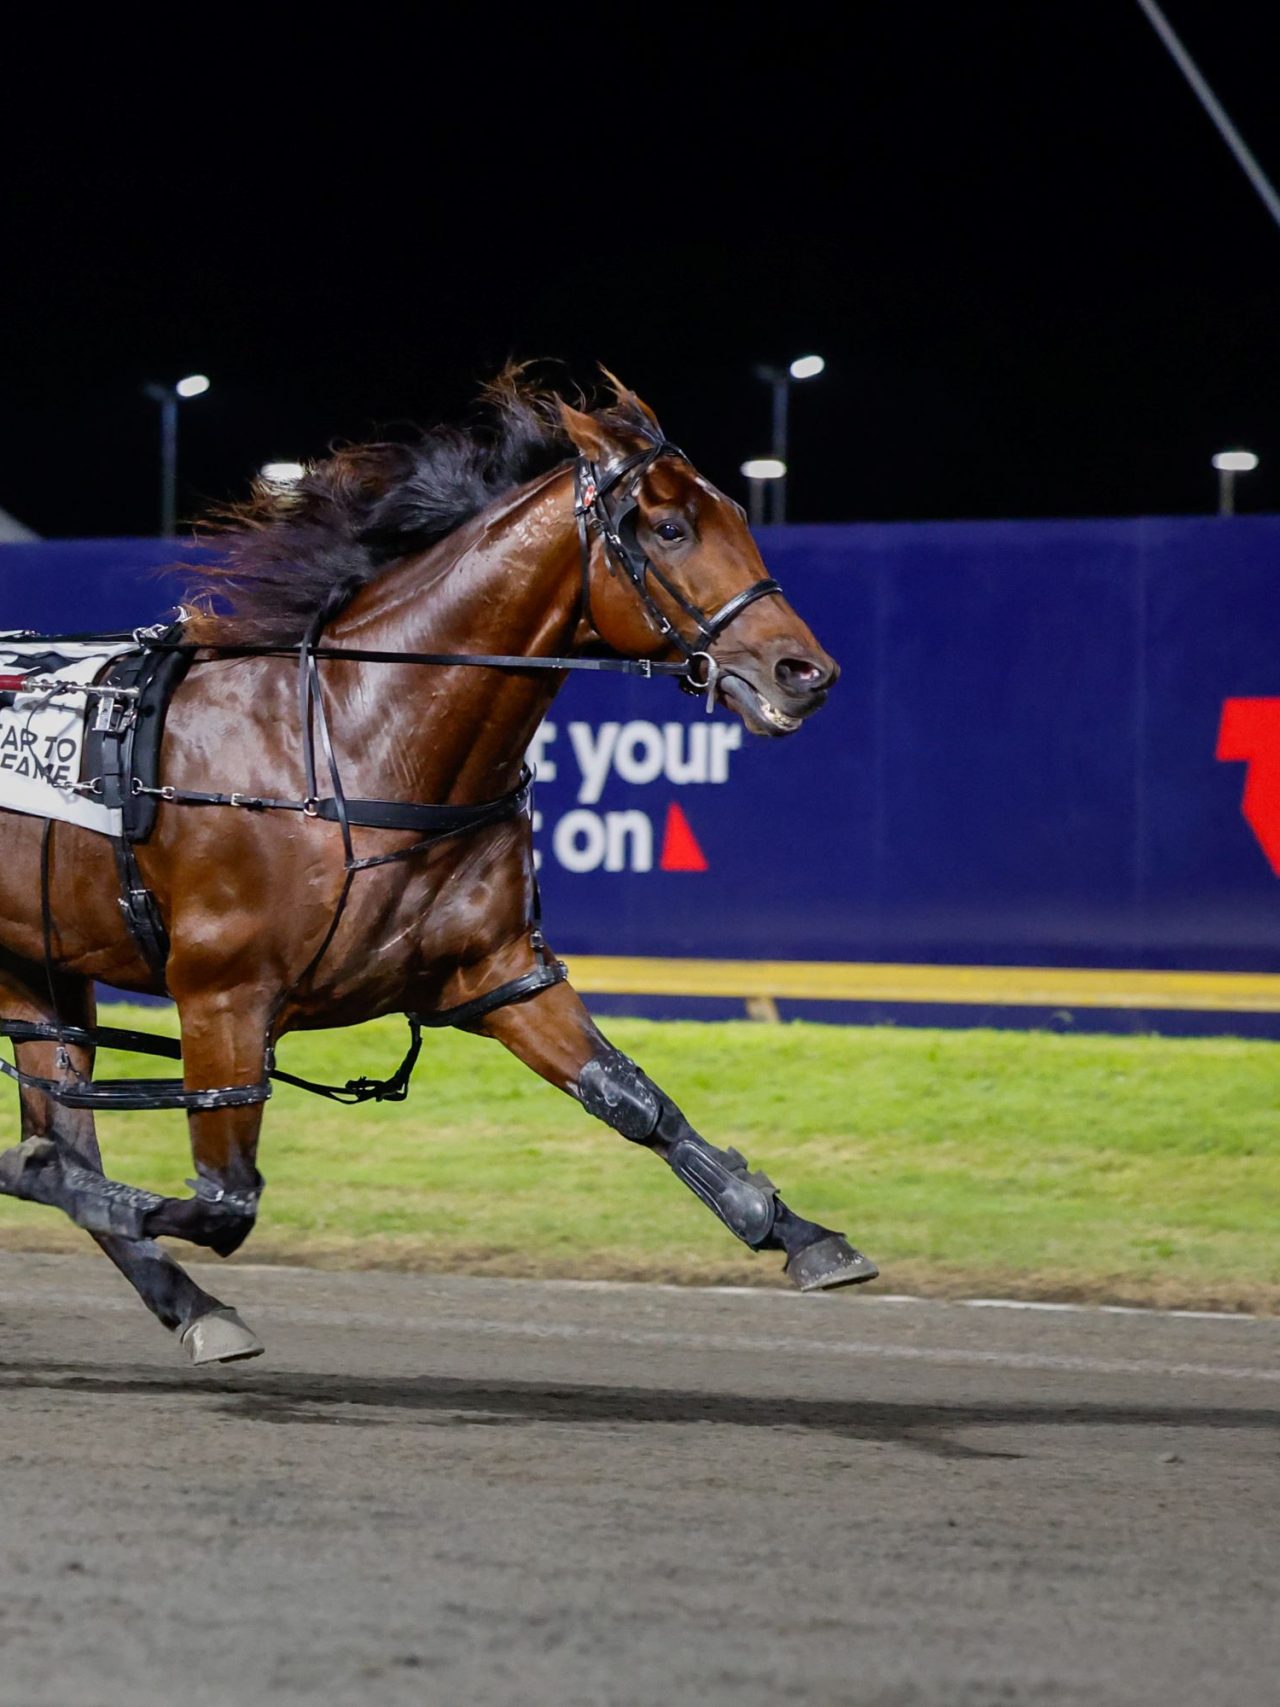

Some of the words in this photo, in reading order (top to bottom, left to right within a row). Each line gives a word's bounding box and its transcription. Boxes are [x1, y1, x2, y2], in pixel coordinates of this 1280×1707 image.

[44, 735, 77, 763] TO
[568, 719, 742, 805] your
[553, 808, 653, 873] on
